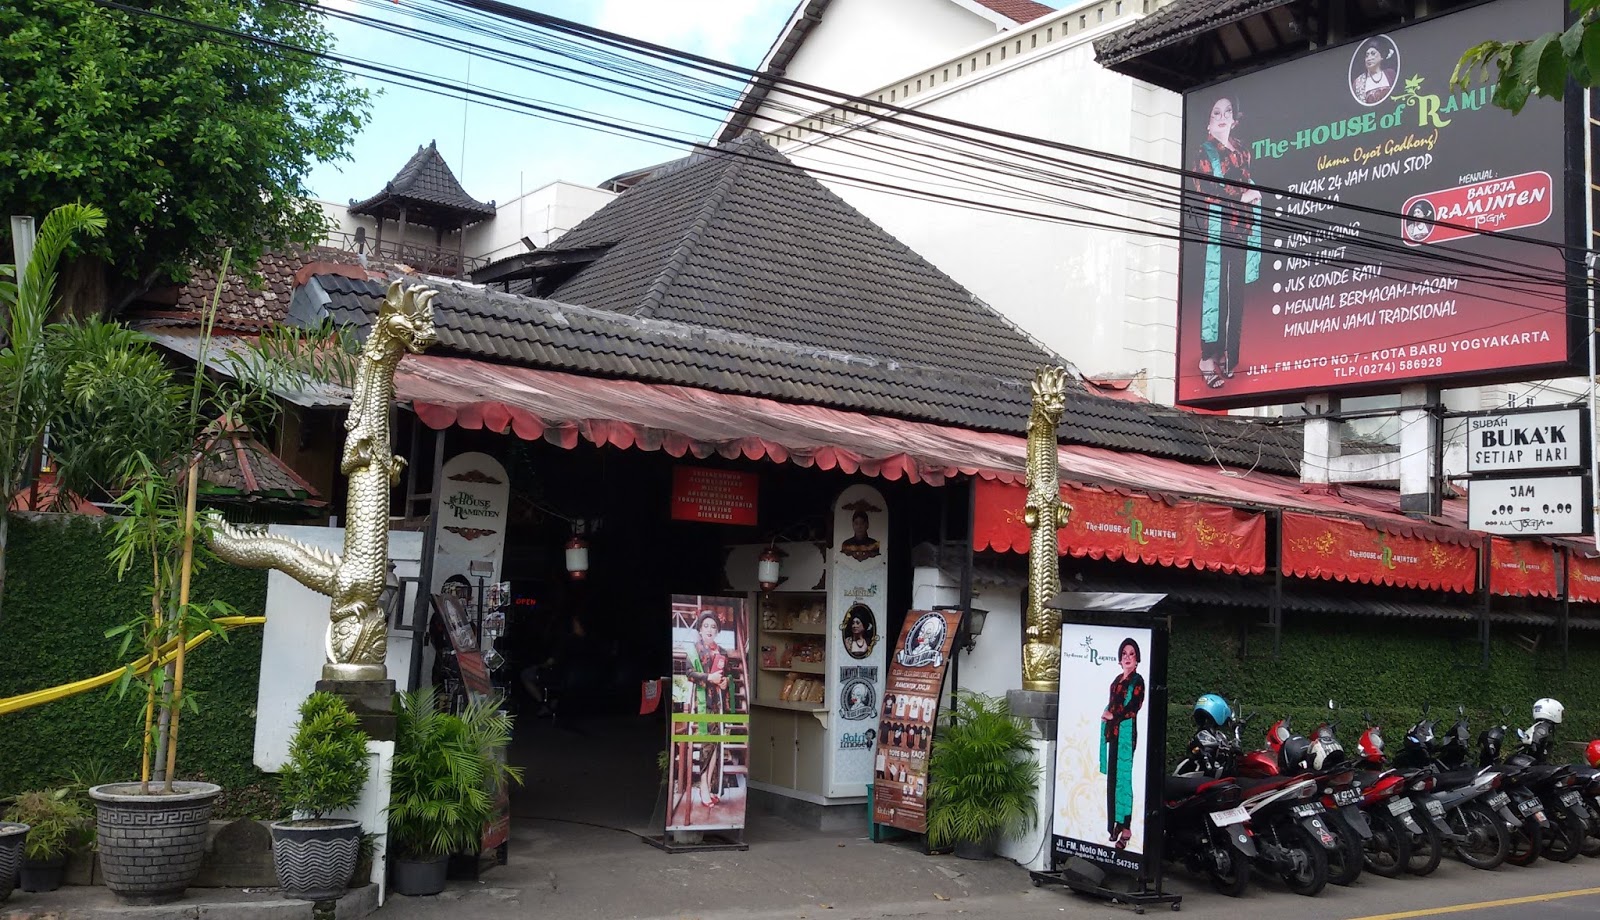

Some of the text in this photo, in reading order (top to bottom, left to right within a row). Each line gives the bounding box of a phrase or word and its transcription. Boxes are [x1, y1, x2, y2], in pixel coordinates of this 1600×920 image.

[1252, 138, 1289, 159] The
[1290, 112, 1377, 150] HOUSE
[1380, 103, 1406, 129] of
[1353, 144, 1382, 165] Oyot
[1328, 175, 1342, 191] 24
[1344, 167, 1369, 187] JAM
[1371, 160, 1400, 181] NON
[1403, 153, 1433, 174] STOP
[1285, 276, 1306, 293] JUS
[1308, 269, 1350, 289] KONDE
[1284, 276, 1458, 315] MENJUAL BERMACAM-MACAM
[1284, 299, 1458, 338] MINUMAN JAMU TRADISIONAL
[1275, 361, 1291, 372] FM
[1294, 357, 1328, 370] NOTO
[1371, 347, 1406, 361] KOTA
[1410, 343, 1447, 357] BARU
[1451, 330, 1550, 352] YOGYAKARTA
[1399, 356, 1443, 371] 586928
[1472, 419, 1508, 429] SUDAH
[1482, 425, 1566, 448] BUKA'K
[1475, 447, 1567, 464] SETIAP HARI
[1510, 485, 1535, 498] JAM
[458, 498, 491, 507] HOUSE
[454, 506, 500, 520] RAMINTEN
[1086, 519, 1177, 545] The HOUSE of RAMINTEN
[515, 598, 536, 606] OPEN
[1066, 840, 1078, 851] FM.
[1080, 843, 1097, 856] Noto
[1097, 847, 1109, 858] No.
[1110, 850, 1116, 859] 7
[1116, 858, 1139, 870] 547315
